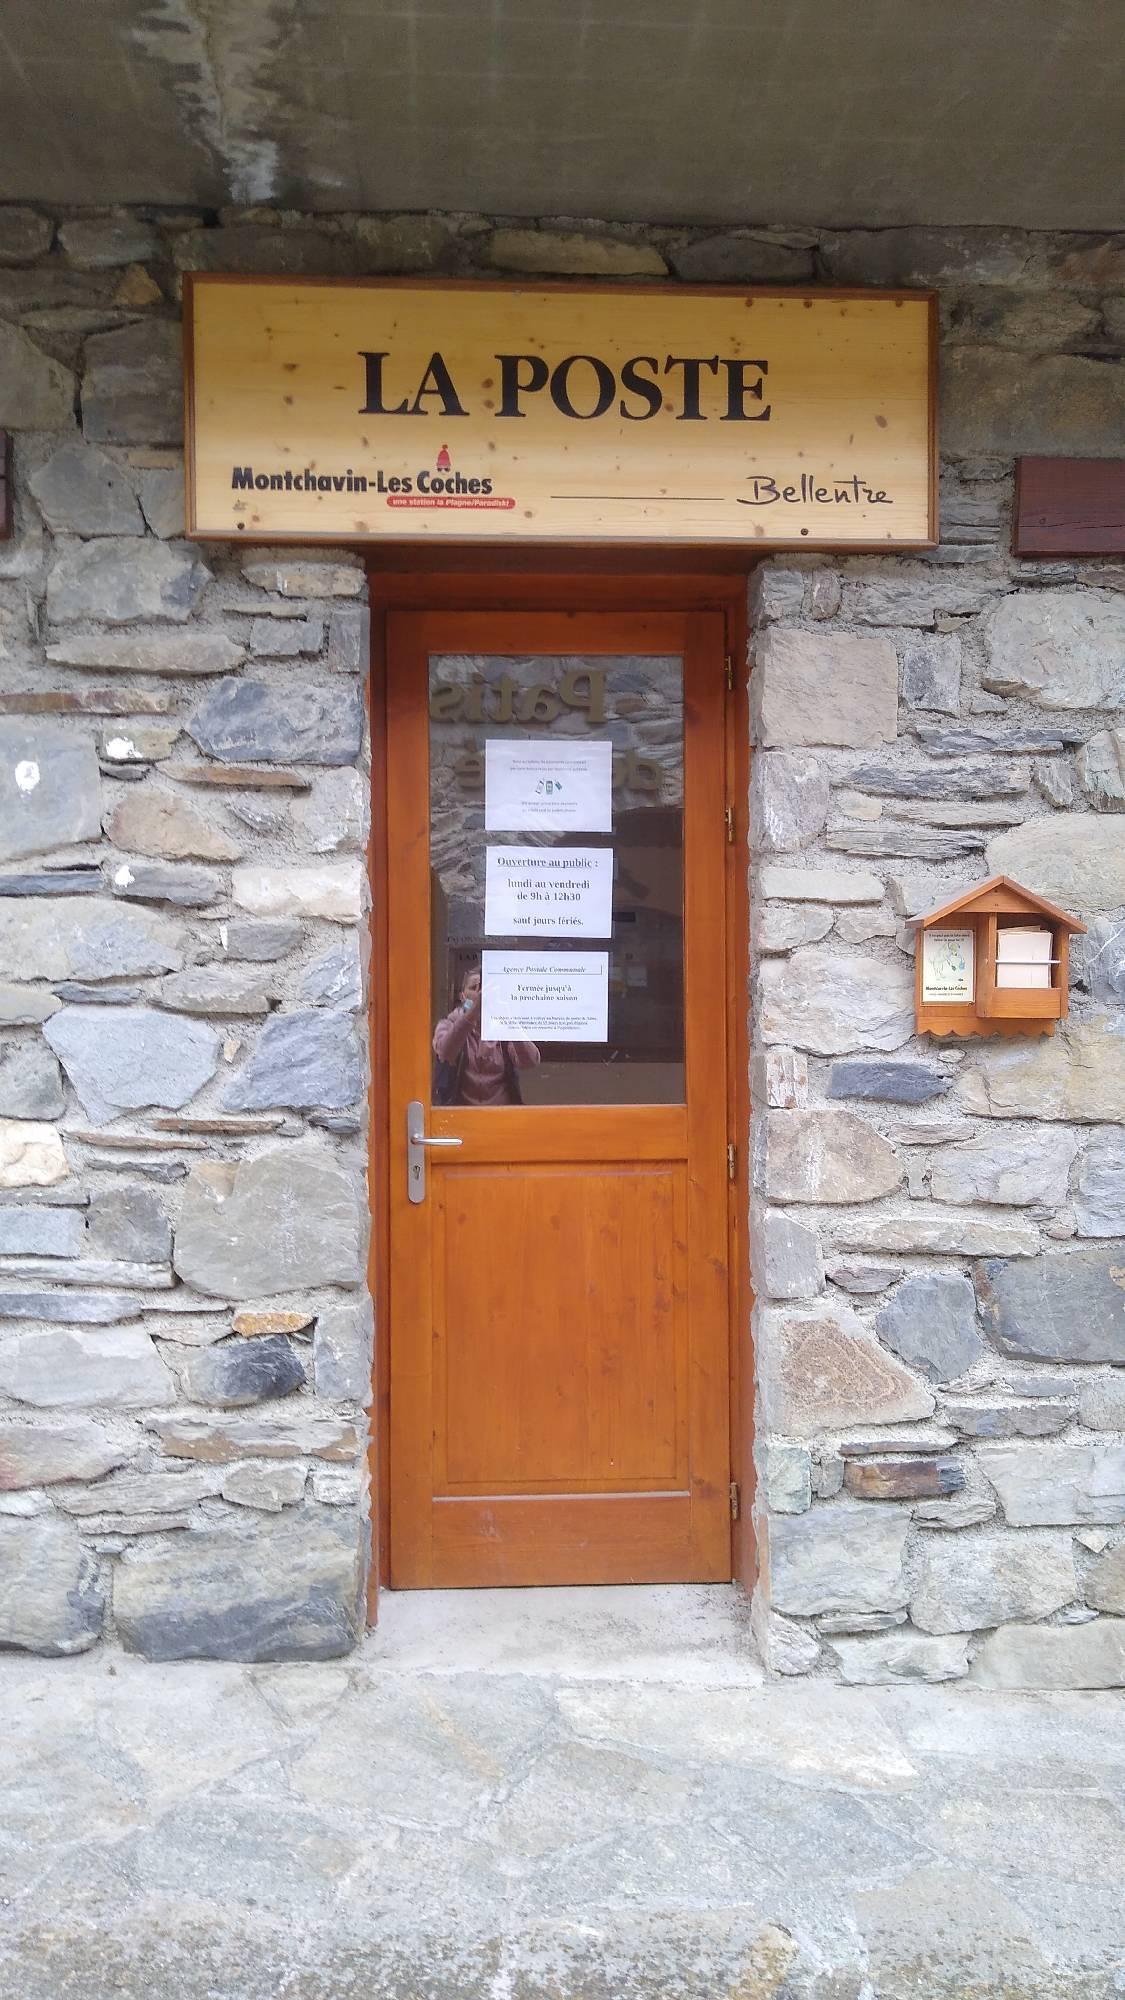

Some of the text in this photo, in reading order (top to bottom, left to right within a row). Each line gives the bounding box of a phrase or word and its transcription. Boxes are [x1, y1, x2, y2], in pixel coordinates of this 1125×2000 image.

[357, 351, 772, 421] LA POSTE
[231, 467, 493, 495] Montchavin-Les Coches
[736, 473, 894, 505] Bellentre
[392, 498, 407, 506] une
[409, 498, 436, 506] station
[497, 856, 547, 868] Ouverture
[548, 859, 561, 868] au
[562, 858, 592, 869] public
[507, 878, 590, 889] lundi au vendredi
[516, 891, 581, 901] de 9h à 12h30
[513, 916, 584, 927] sauf jours fériés.
